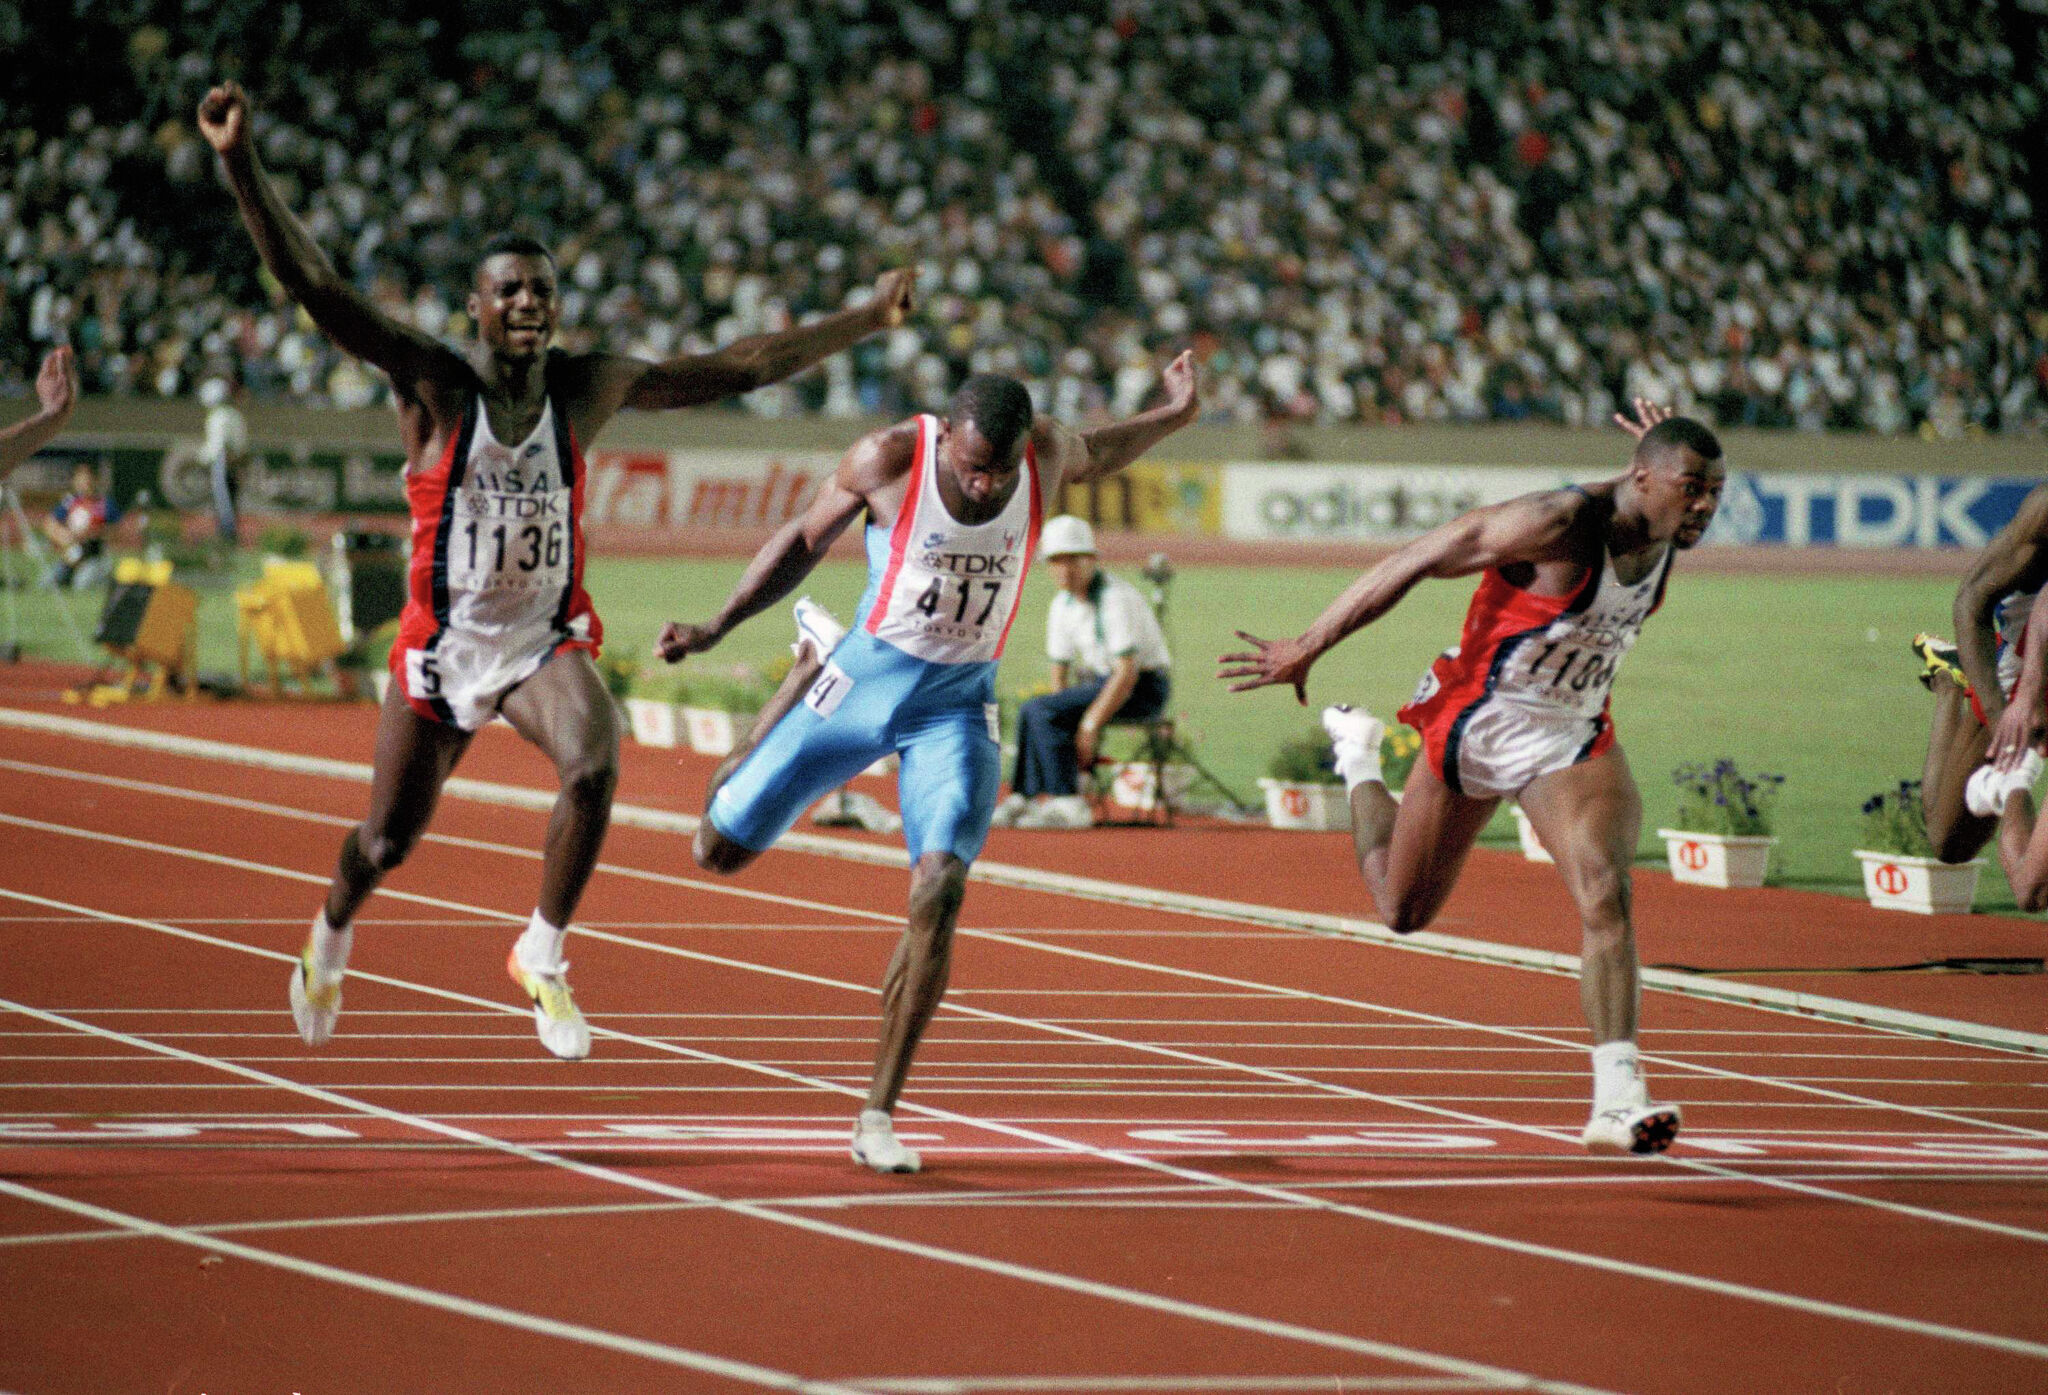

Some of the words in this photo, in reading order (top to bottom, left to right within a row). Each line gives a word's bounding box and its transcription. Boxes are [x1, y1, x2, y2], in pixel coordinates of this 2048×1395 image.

[491, 495, 558, 518] TDK
[1757, 476, 1993, 547] TDK
[465, 520, 562, 572] 1136
[943, 553, 1009, 574] TDK
[916, 577, 1001, 626] 417
[421, 658, 440, 694] 5
[814, 673, 839, 709] 4
